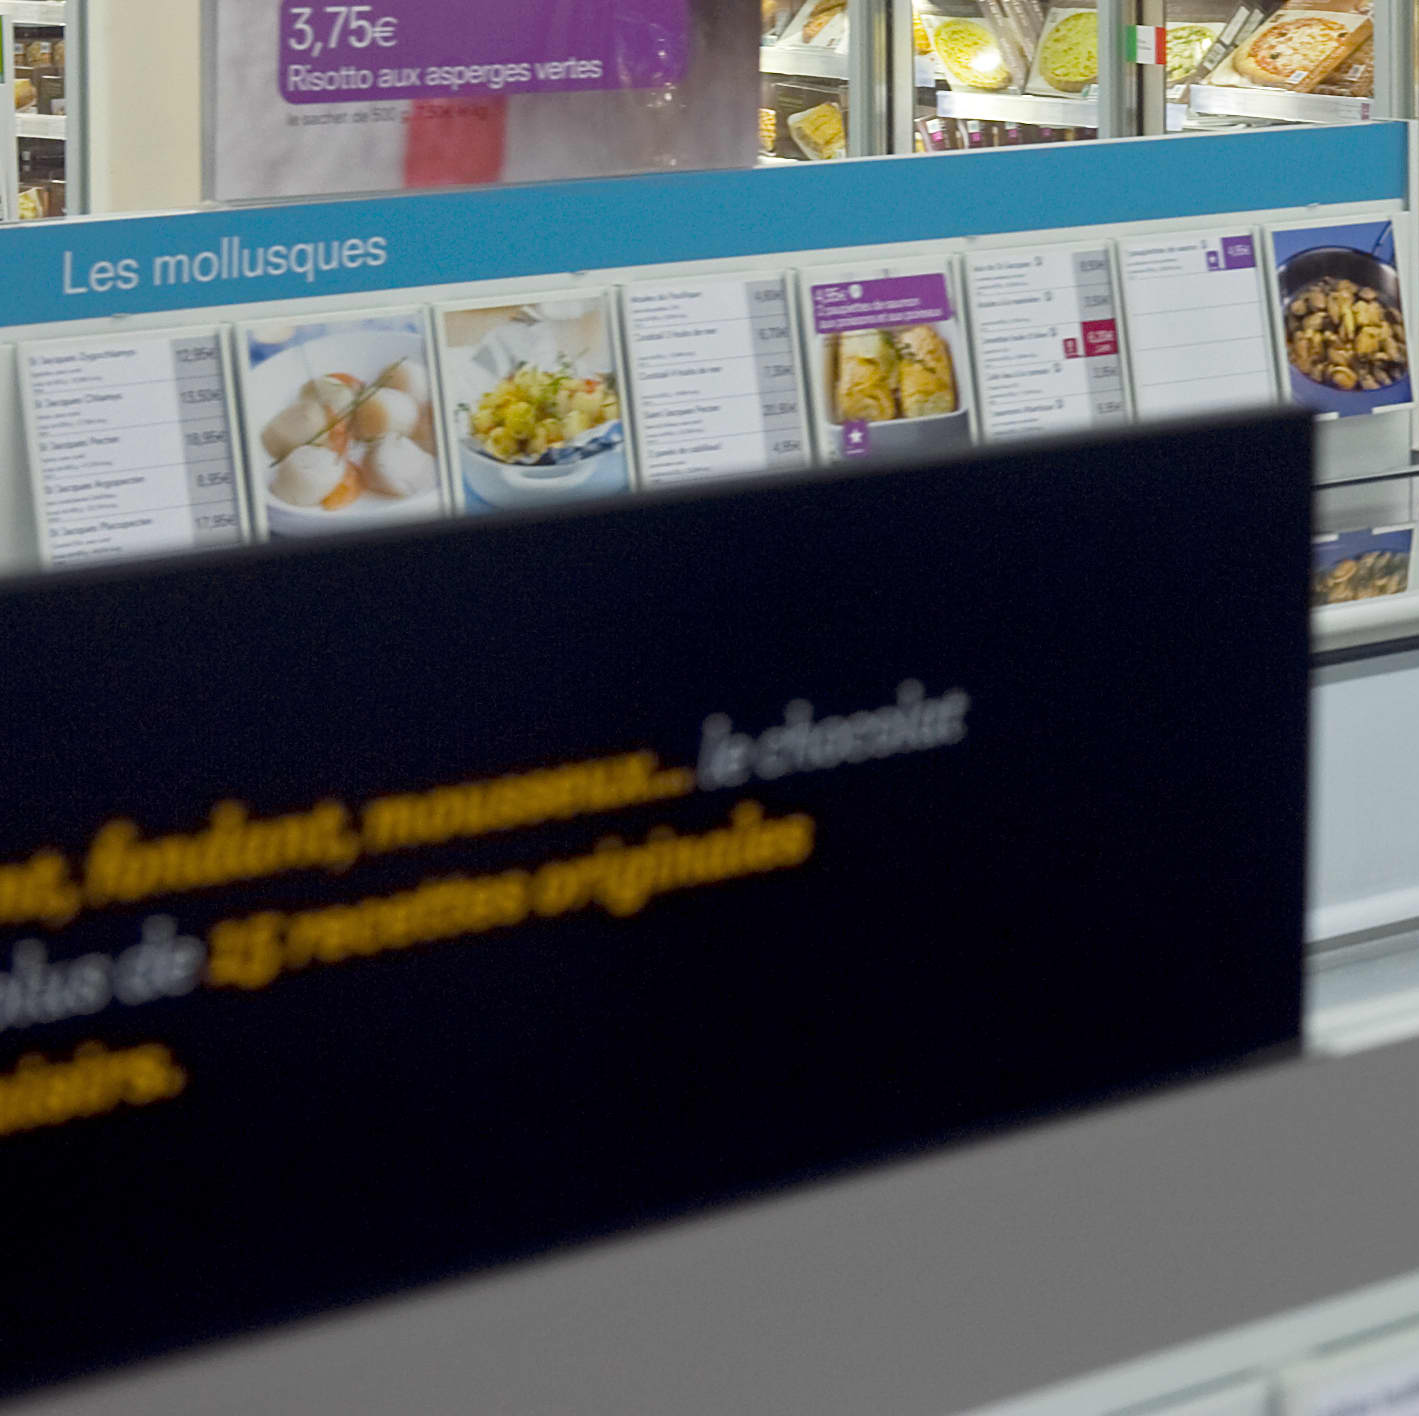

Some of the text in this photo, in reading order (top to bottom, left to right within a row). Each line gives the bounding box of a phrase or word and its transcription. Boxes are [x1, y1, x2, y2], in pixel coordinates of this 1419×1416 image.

[287, 5, 398, 57] 3,75€
[287, 57, 604, 92] Risotto aux asperges vertes
[61, 235, 389, 295] Les mollusques
